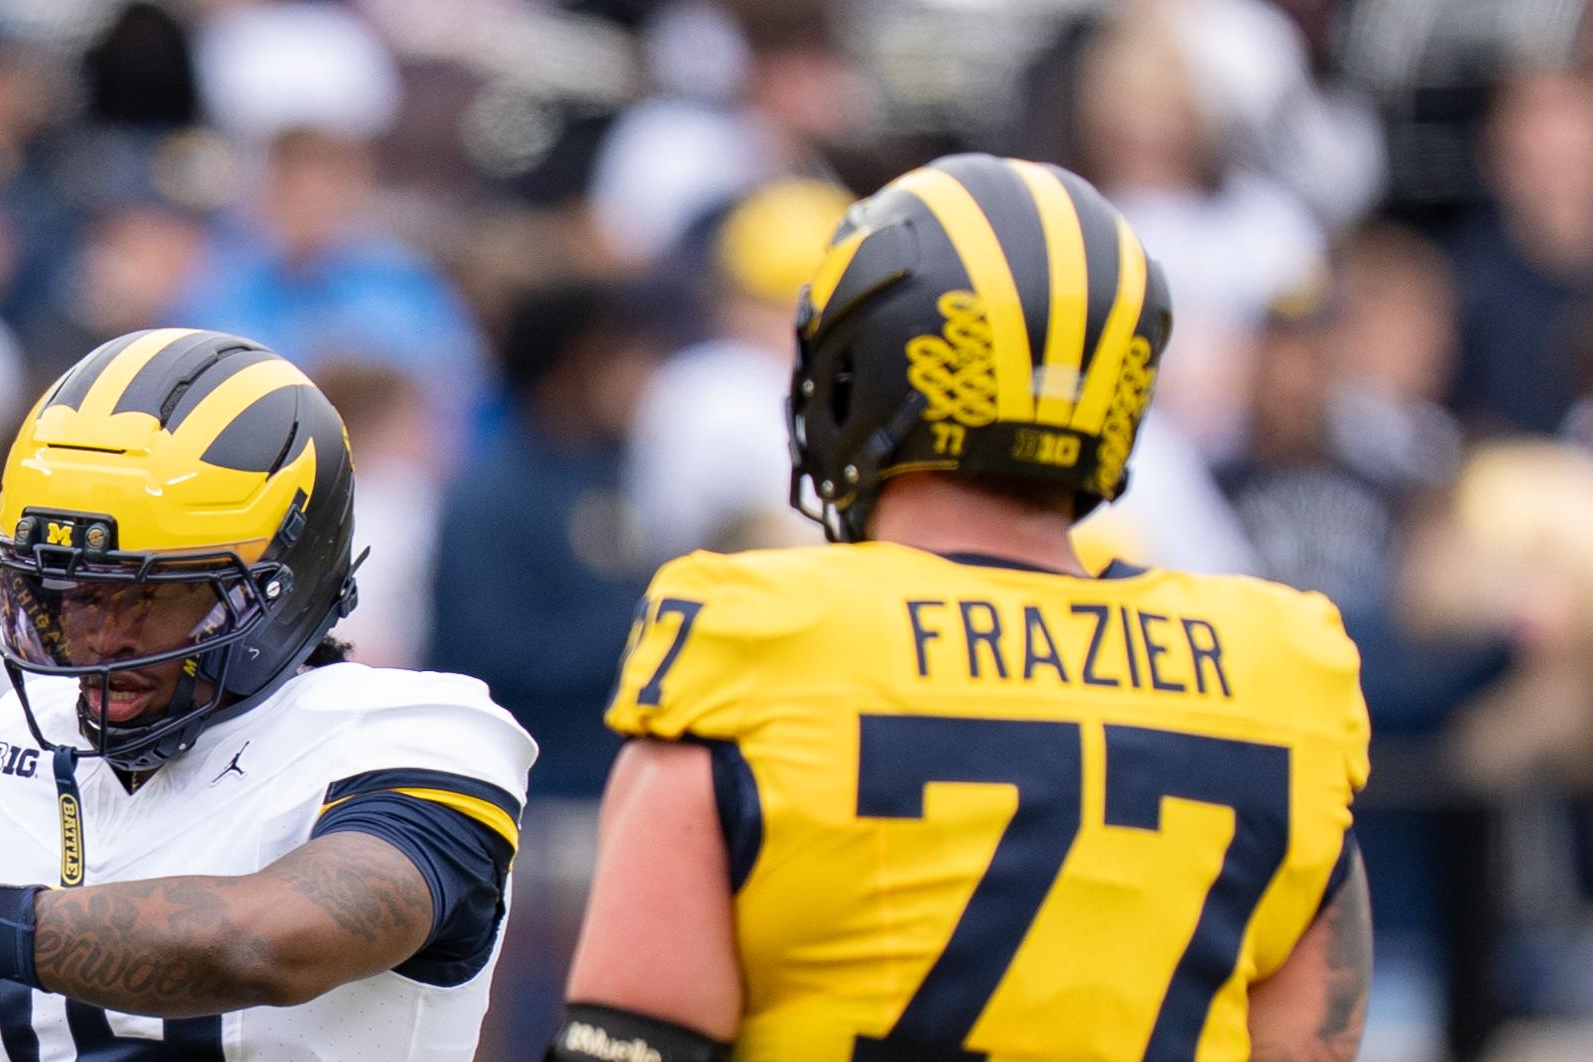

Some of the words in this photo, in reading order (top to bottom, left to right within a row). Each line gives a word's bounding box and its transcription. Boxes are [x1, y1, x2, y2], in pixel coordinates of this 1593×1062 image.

[47, 522, 72, 547] M
[906, 599, 1233, 698] FRAZIER
[63, 801, 79, 877] BATTLE
